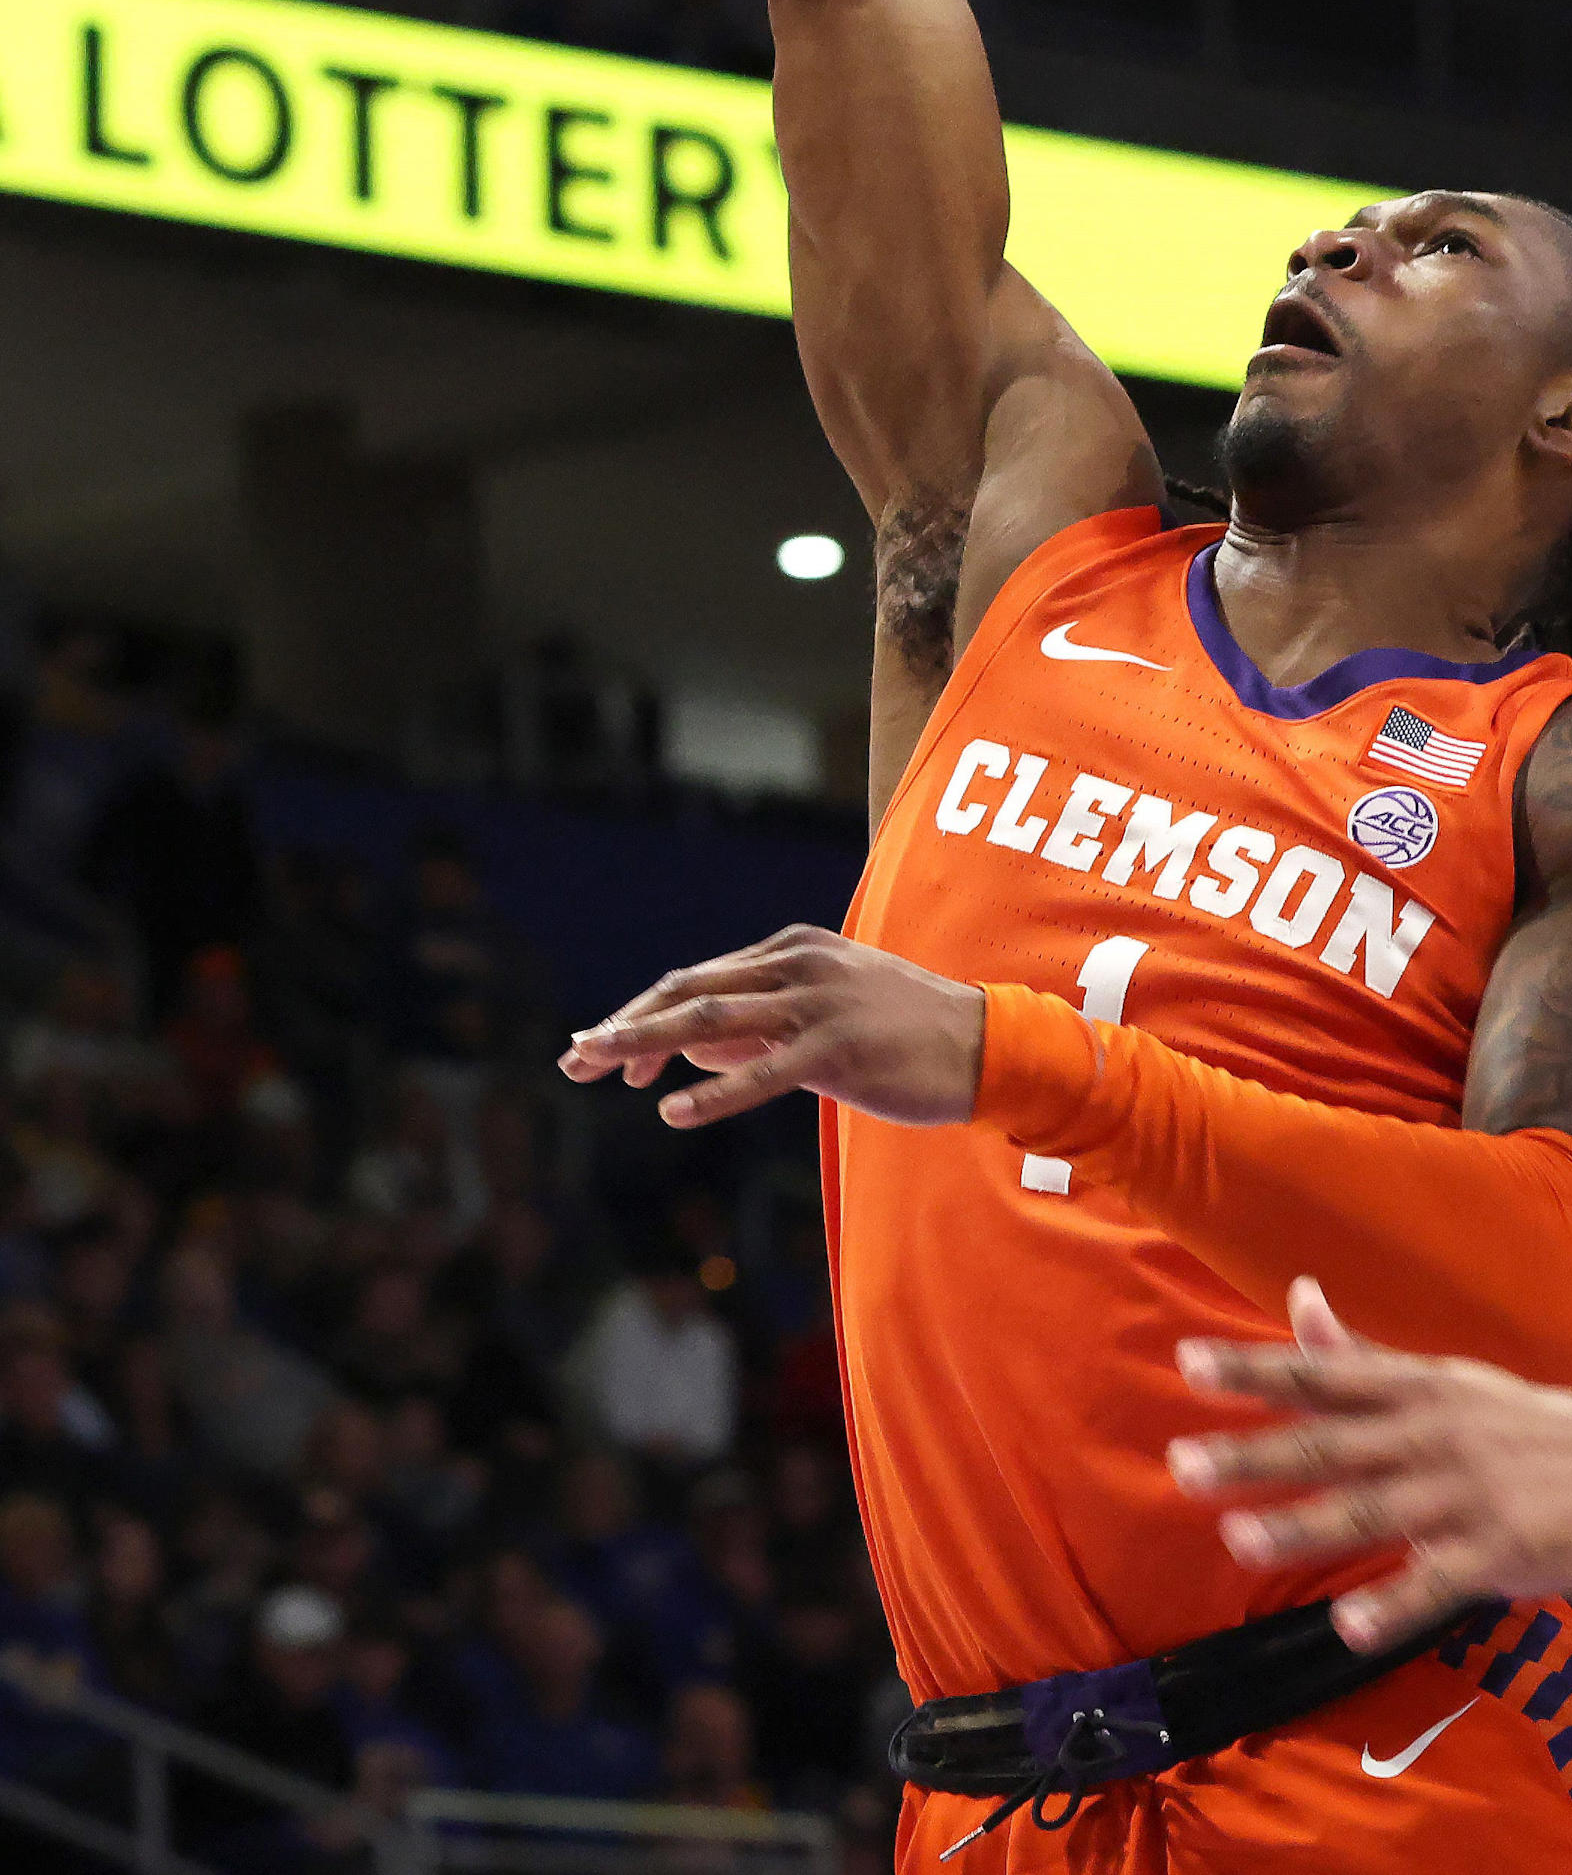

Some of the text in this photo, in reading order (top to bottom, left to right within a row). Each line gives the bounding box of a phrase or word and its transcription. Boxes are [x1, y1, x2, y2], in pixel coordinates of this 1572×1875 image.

[82, 22, 780, 262] LOTTER
[934, 737, 1437, 1001] CLEMSON
[1365, 810, 1434, 841] ACC
